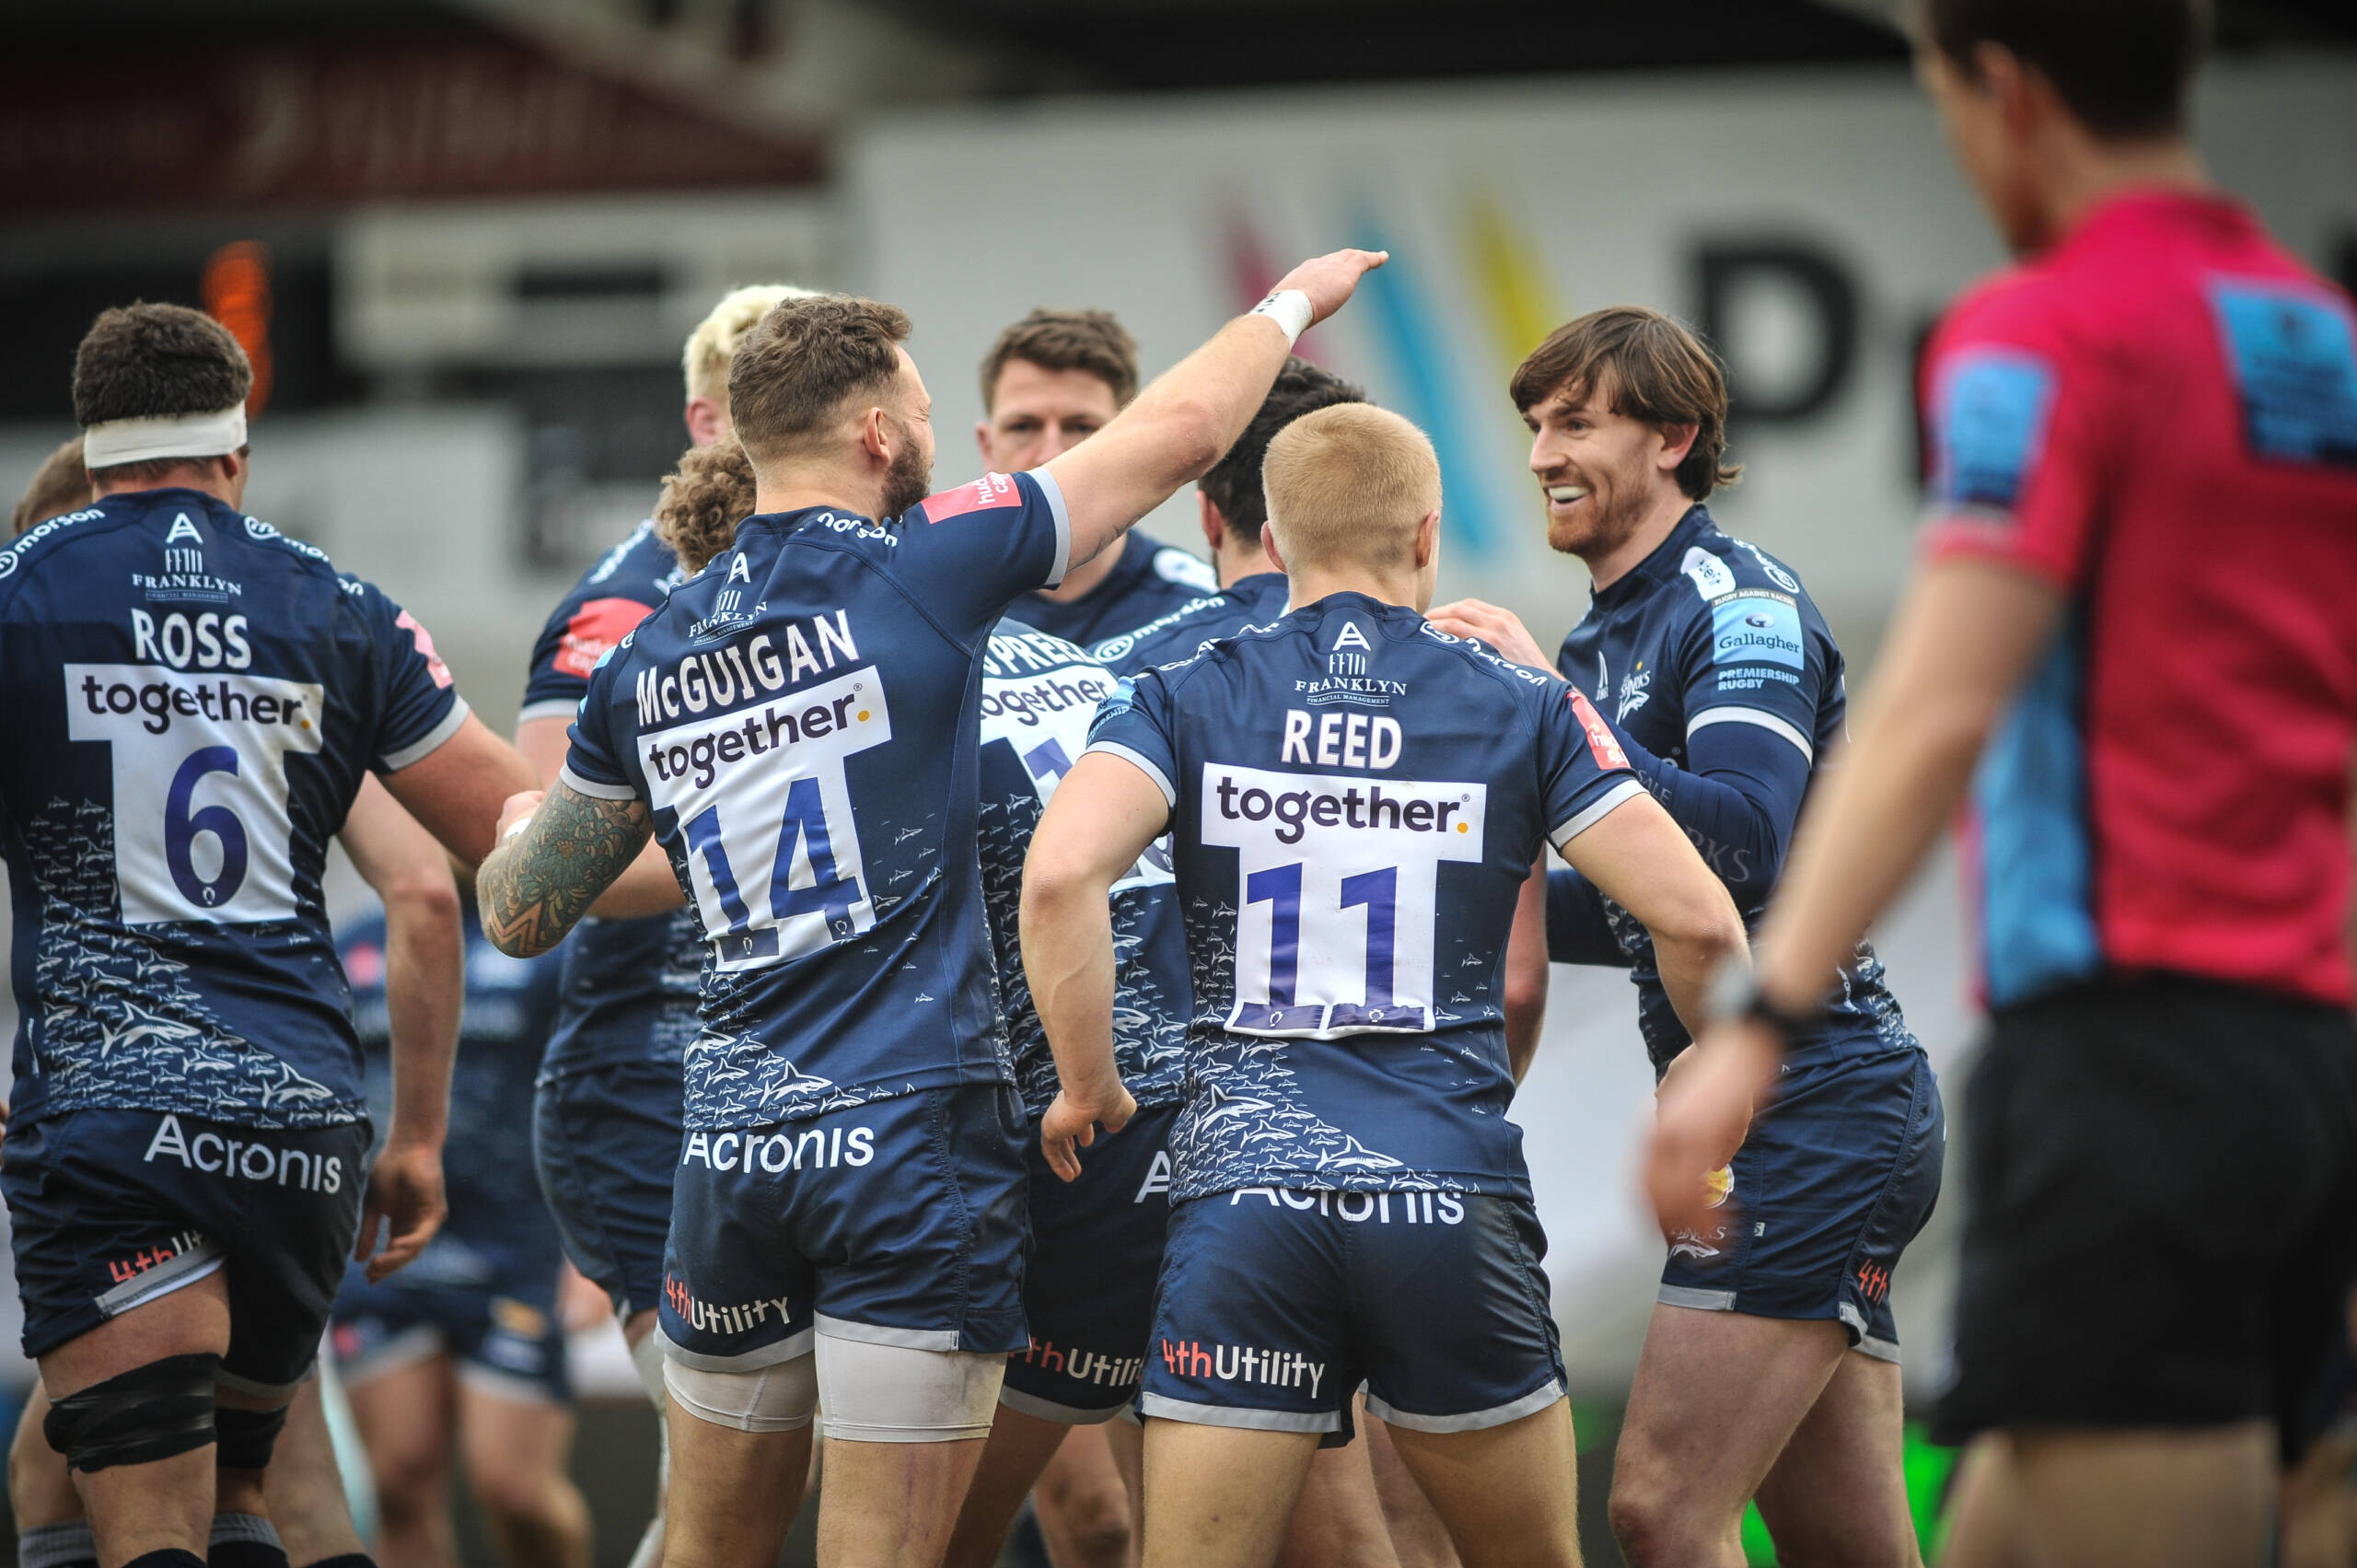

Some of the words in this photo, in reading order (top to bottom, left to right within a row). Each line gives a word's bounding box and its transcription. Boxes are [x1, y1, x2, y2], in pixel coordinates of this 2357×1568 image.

[15, 508, 106, 553] morson
[132, 573, 242, 597] FRANKLYN
[131, 608, 252, 669] ROSS
[1719, 633, 1800, 654] Gallagher
[635, 608, 861, 728] McGUIGAN
[1295, 677, 1408, 696] FRANKLYN
[1718, 668, 1800, 685] PREMIERSHIP
[1718, 679, 1764, 691] RUGBY
[1307, 694, 1341, 703] FINANCIAL
[1343, 694, 1389, 704] MANAGEMENT
[1281, 709, 1403, 770] REED
[164, 746, 249, 909] 6
[685, 776, 866, 963] 14
[1232, 861, 1427, 1031] 11
[145, 1114, 343, 1194] Acronis
[683, 1126, 875, 1174] Acronis
